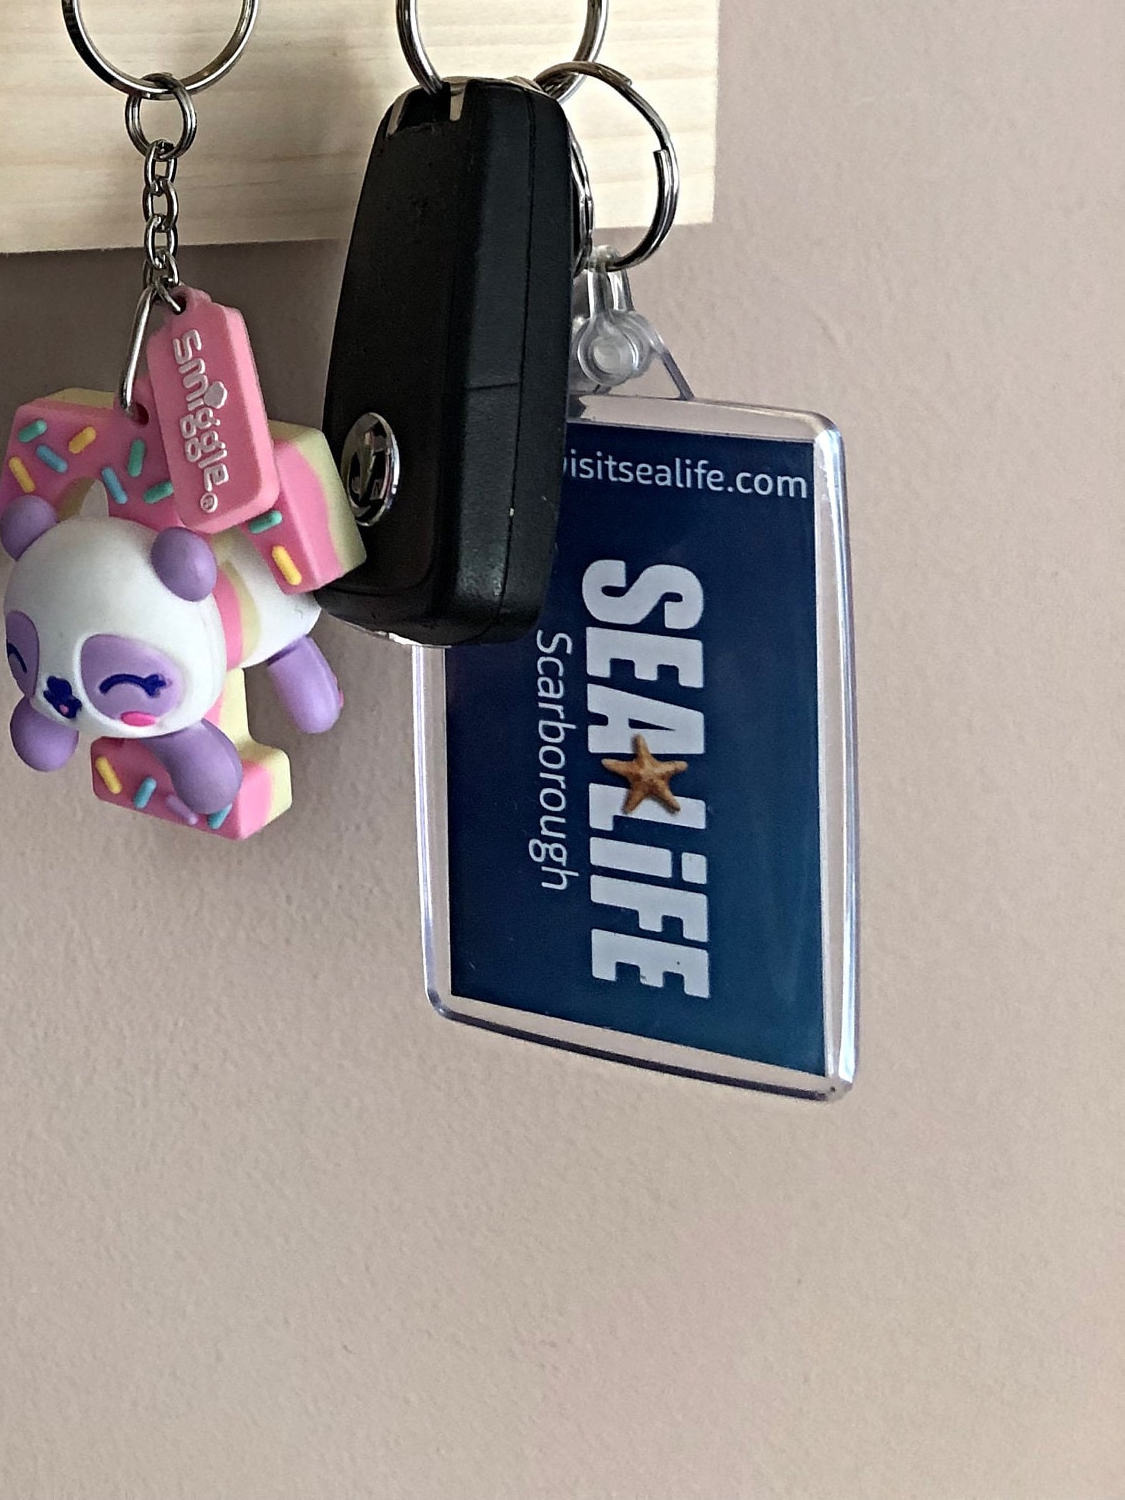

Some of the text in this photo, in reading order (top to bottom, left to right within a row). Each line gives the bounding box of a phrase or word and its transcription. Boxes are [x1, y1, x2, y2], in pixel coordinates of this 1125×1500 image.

[562, 448, 808, 499] isitsealife.com
[581, 559, 705, 755] SEA
[528, 629, 579, 890] Scarborough
